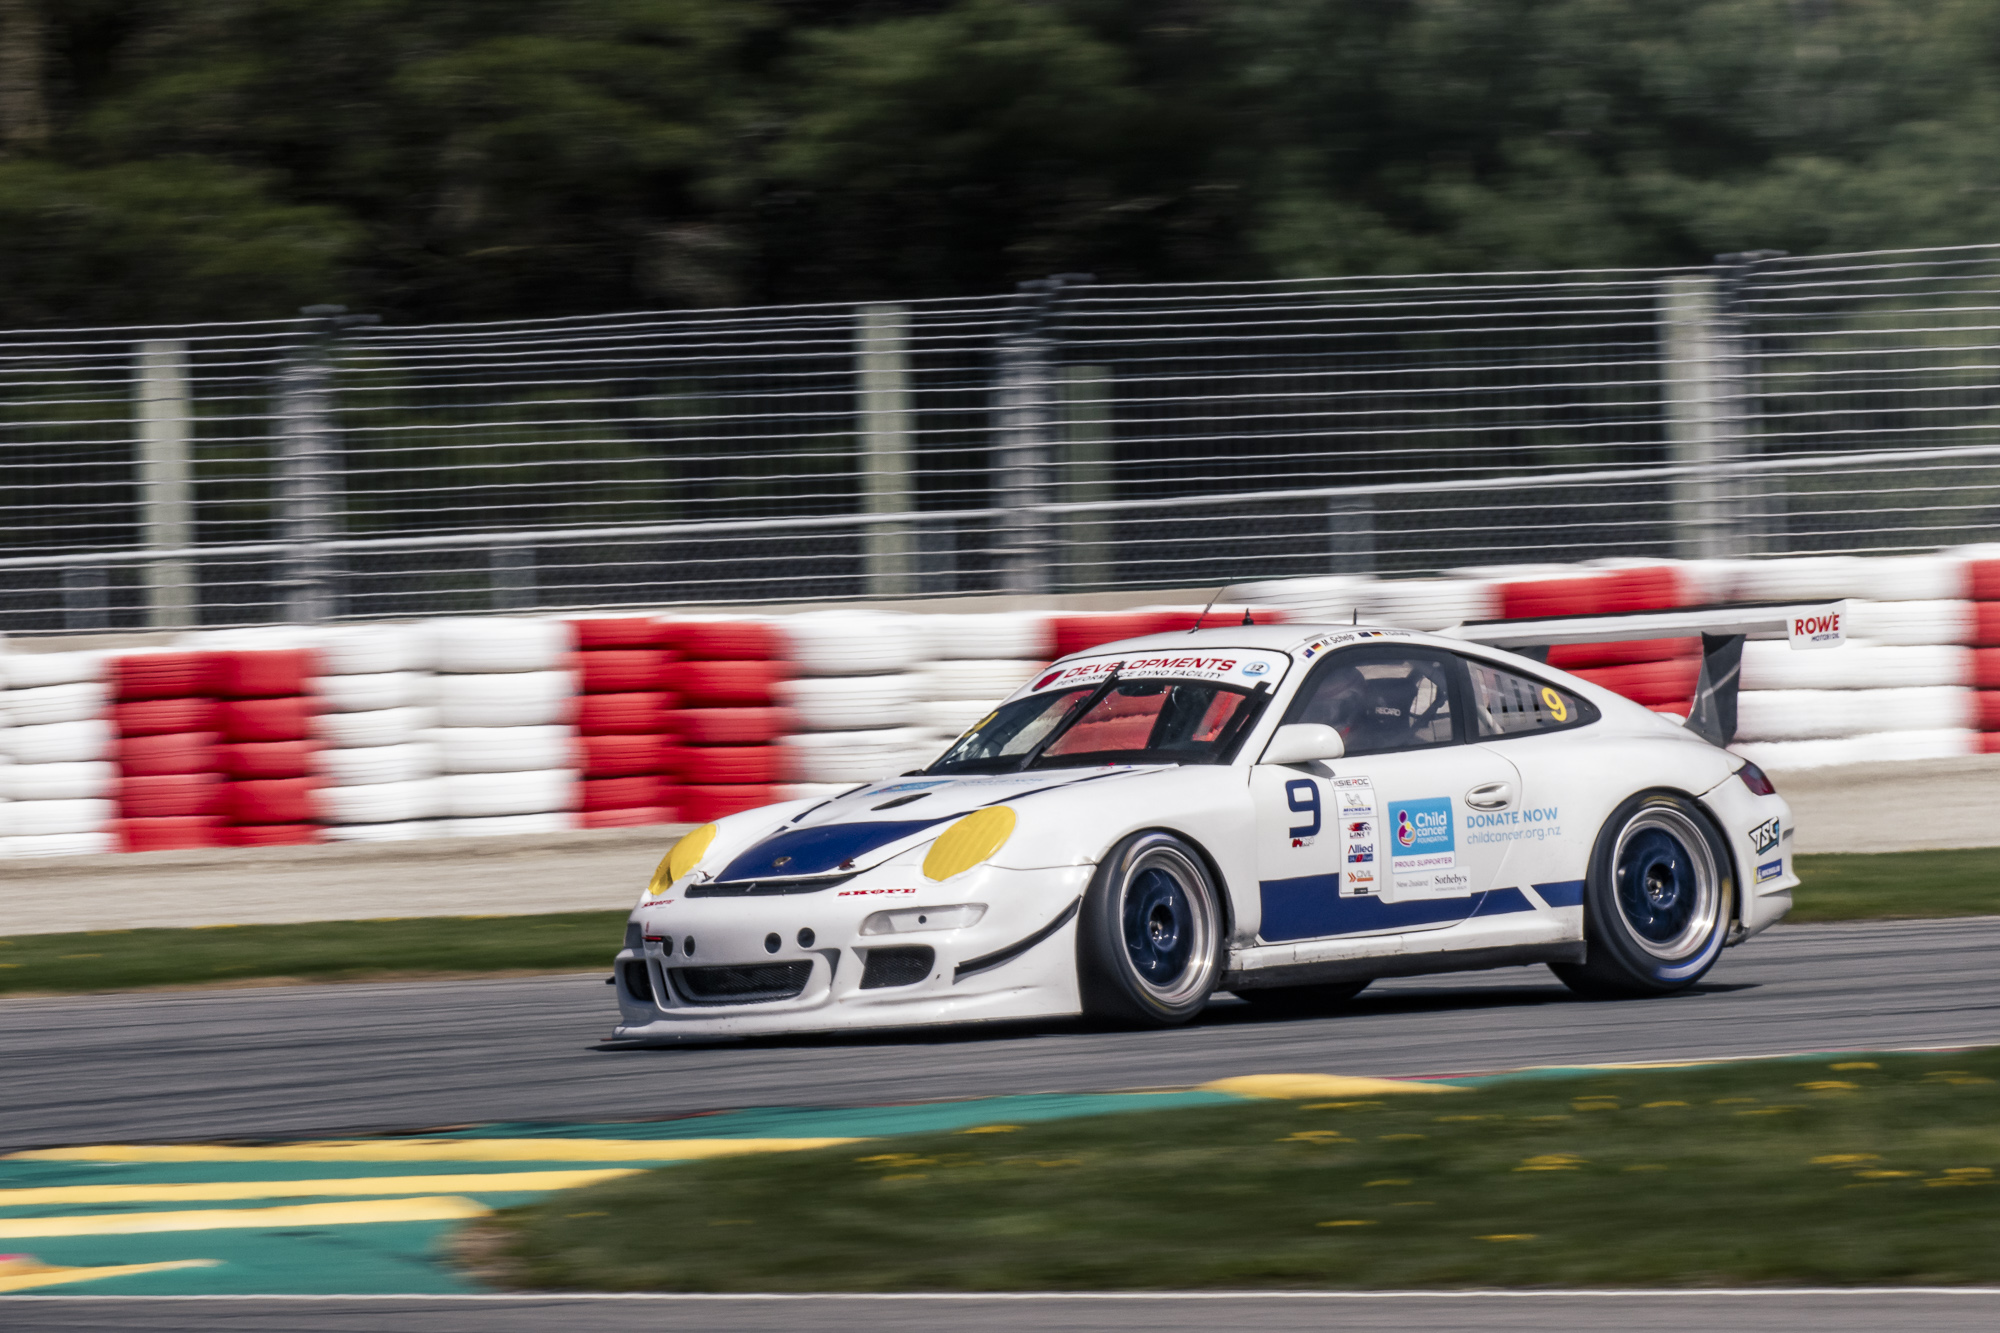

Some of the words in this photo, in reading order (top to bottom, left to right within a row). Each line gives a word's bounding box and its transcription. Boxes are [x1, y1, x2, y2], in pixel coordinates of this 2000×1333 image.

[1794, 614, 1840, 636] ROWE
[1136, 670, 1169, 678] DYNO
[1171, 670, 1224, 679] FACILITY
[1541, 687, 1568, 722] 9
[1285, 778, 1321, 839] 9
[1415, 811, 1447, 827] Child
[1466, 811, 1519, 829] DONATE
[1523, 807, 1558, 823] NOW
[1416, 826, 1447, 837] cancer
[1466, 826, 1561, 844] childcancer.org.nz
[1417, 836, 1449, 844] FOUNDATION
[1347, 844, 1373, 854] Allied
[1394, 860, 1416, 868] PROUD
[1417, 857, 1452, 867] SUPPORTER
[1434, 873, 1468, 885] Sotheby's
[838, 888, 918, 897] SKOPE
